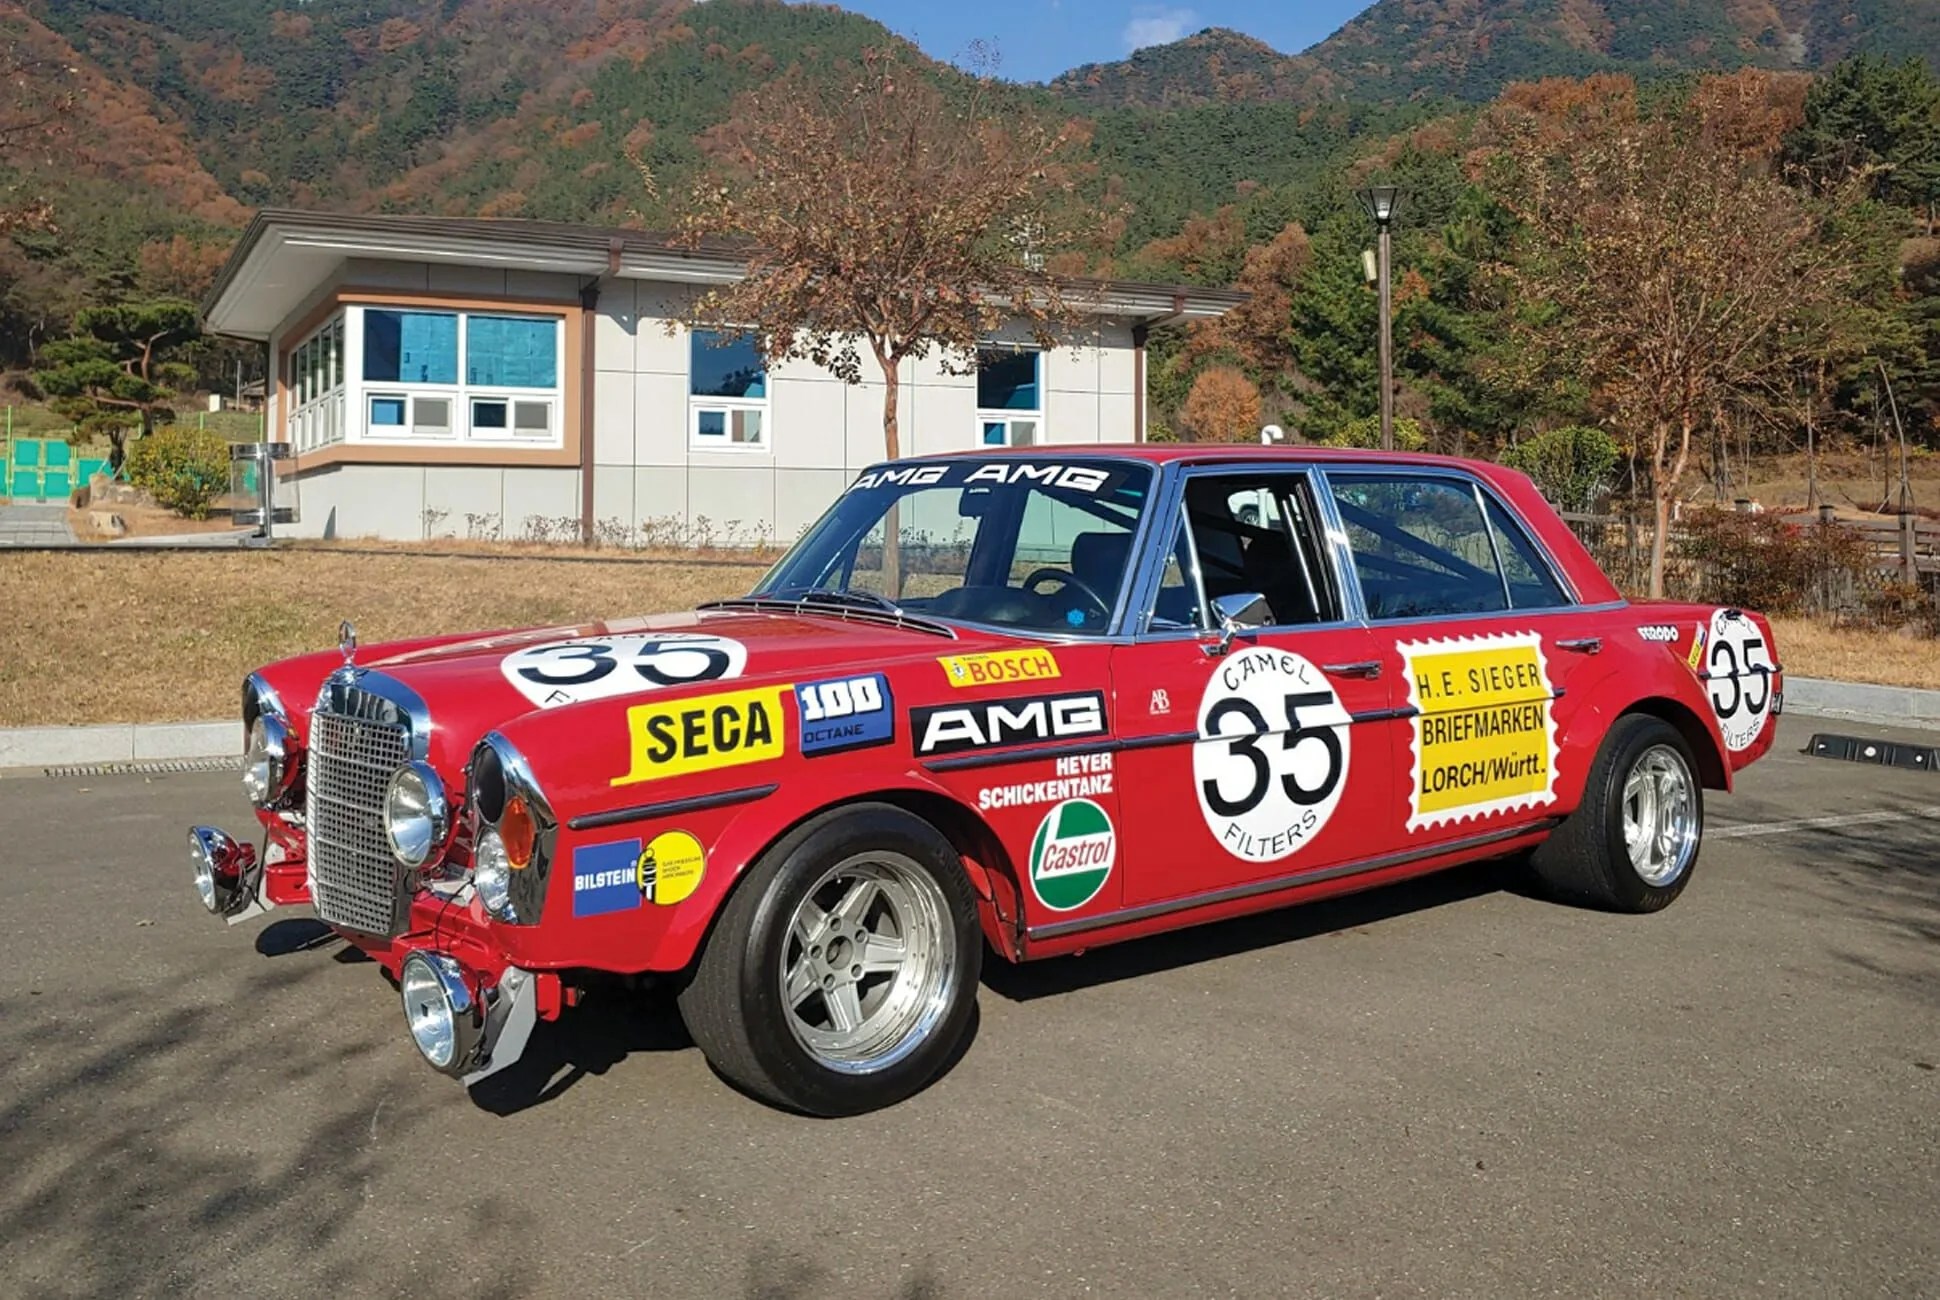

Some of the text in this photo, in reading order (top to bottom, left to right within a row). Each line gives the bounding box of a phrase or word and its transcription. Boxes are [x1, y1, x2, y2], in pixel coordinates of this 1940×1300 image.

[848, 464, 1110, 492] AMG AMG
[517, 638, 730, 686] 35
[968, 656, 1053, 682] BOSCH
[1223, 653, 1309, 691] CAMEL
[1468, 663, 1540, 693] SIEGER
[1711, 639, 1768, 719] 35
[801, 677, 882, 721] 100
[646, 701, 772, 764] SECA
[804, 724, 865, 743] OCTANE
[920, 696, 1102, 751] AMG
[1422, 704, 1544, 746] BRIEFMARKEN
[1056, 752, 1112, 776] HEYER
[1203, 691, 1342, 817] 35
[1422, 752, 1546, 794] LORCH/Württ.
[979, 773, 1112, 810] SCHICKENTANZ
[1042, 835, 1112, 872] Castrol
[1223, 809, 1317, 858] FILTERS
[574, 868, 636, 891] BILSTEIN
